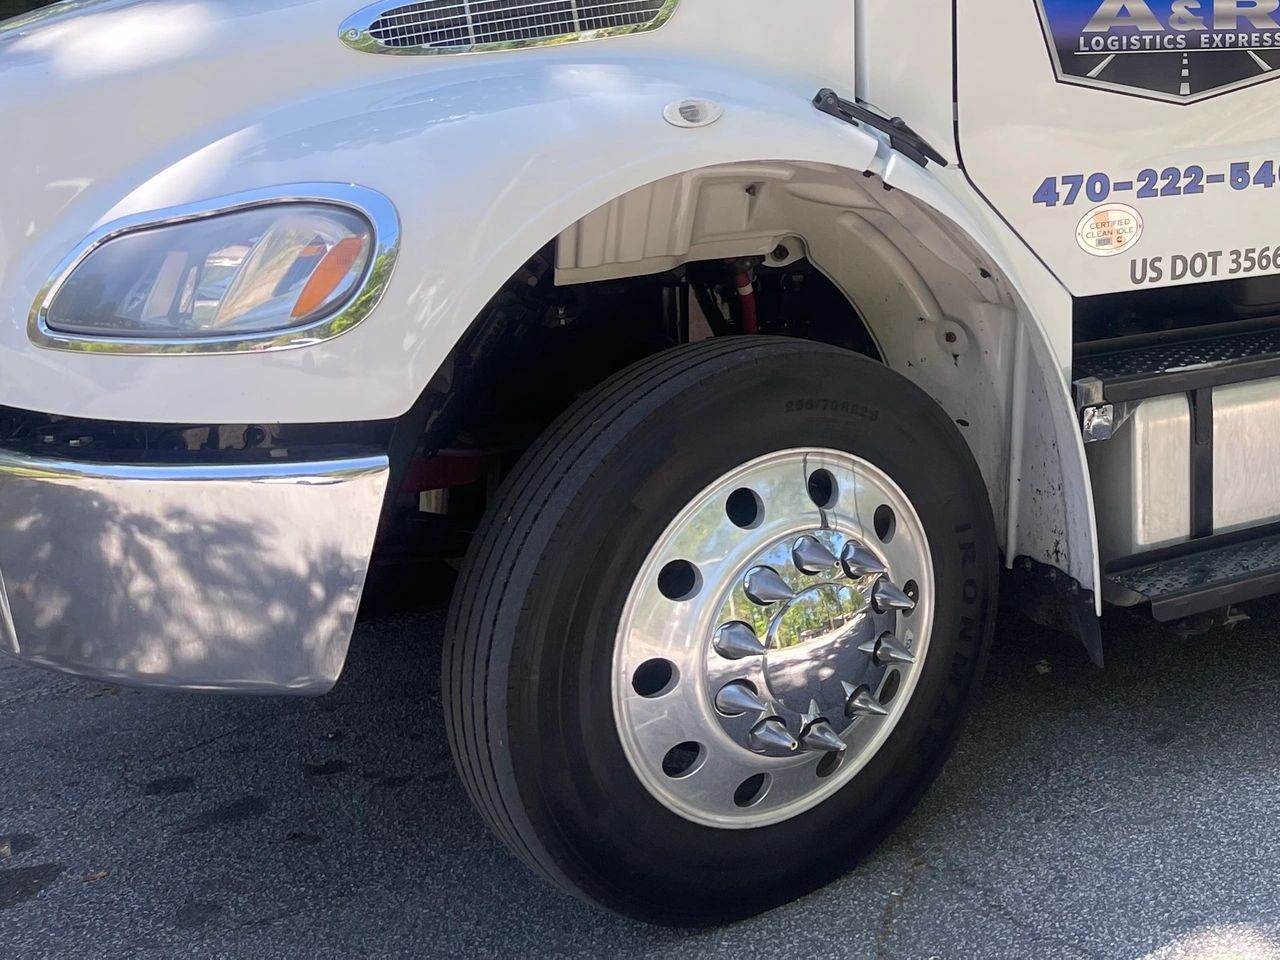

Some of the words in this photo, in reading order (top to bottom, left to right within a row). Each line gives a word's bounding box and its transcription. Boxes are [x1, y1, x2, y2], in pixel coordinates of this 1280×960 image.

[1079, 34, 1187, 52] LOGISTICS
[1089, 218, 1131, 230] CERTIFIED
[1085, 229, 1114, 239] CLEAN
[1116, 227, 1134, 236] IDLE
[1130, 257, 1163, 285] US
[1170, 250, 1224, 281] DOT
